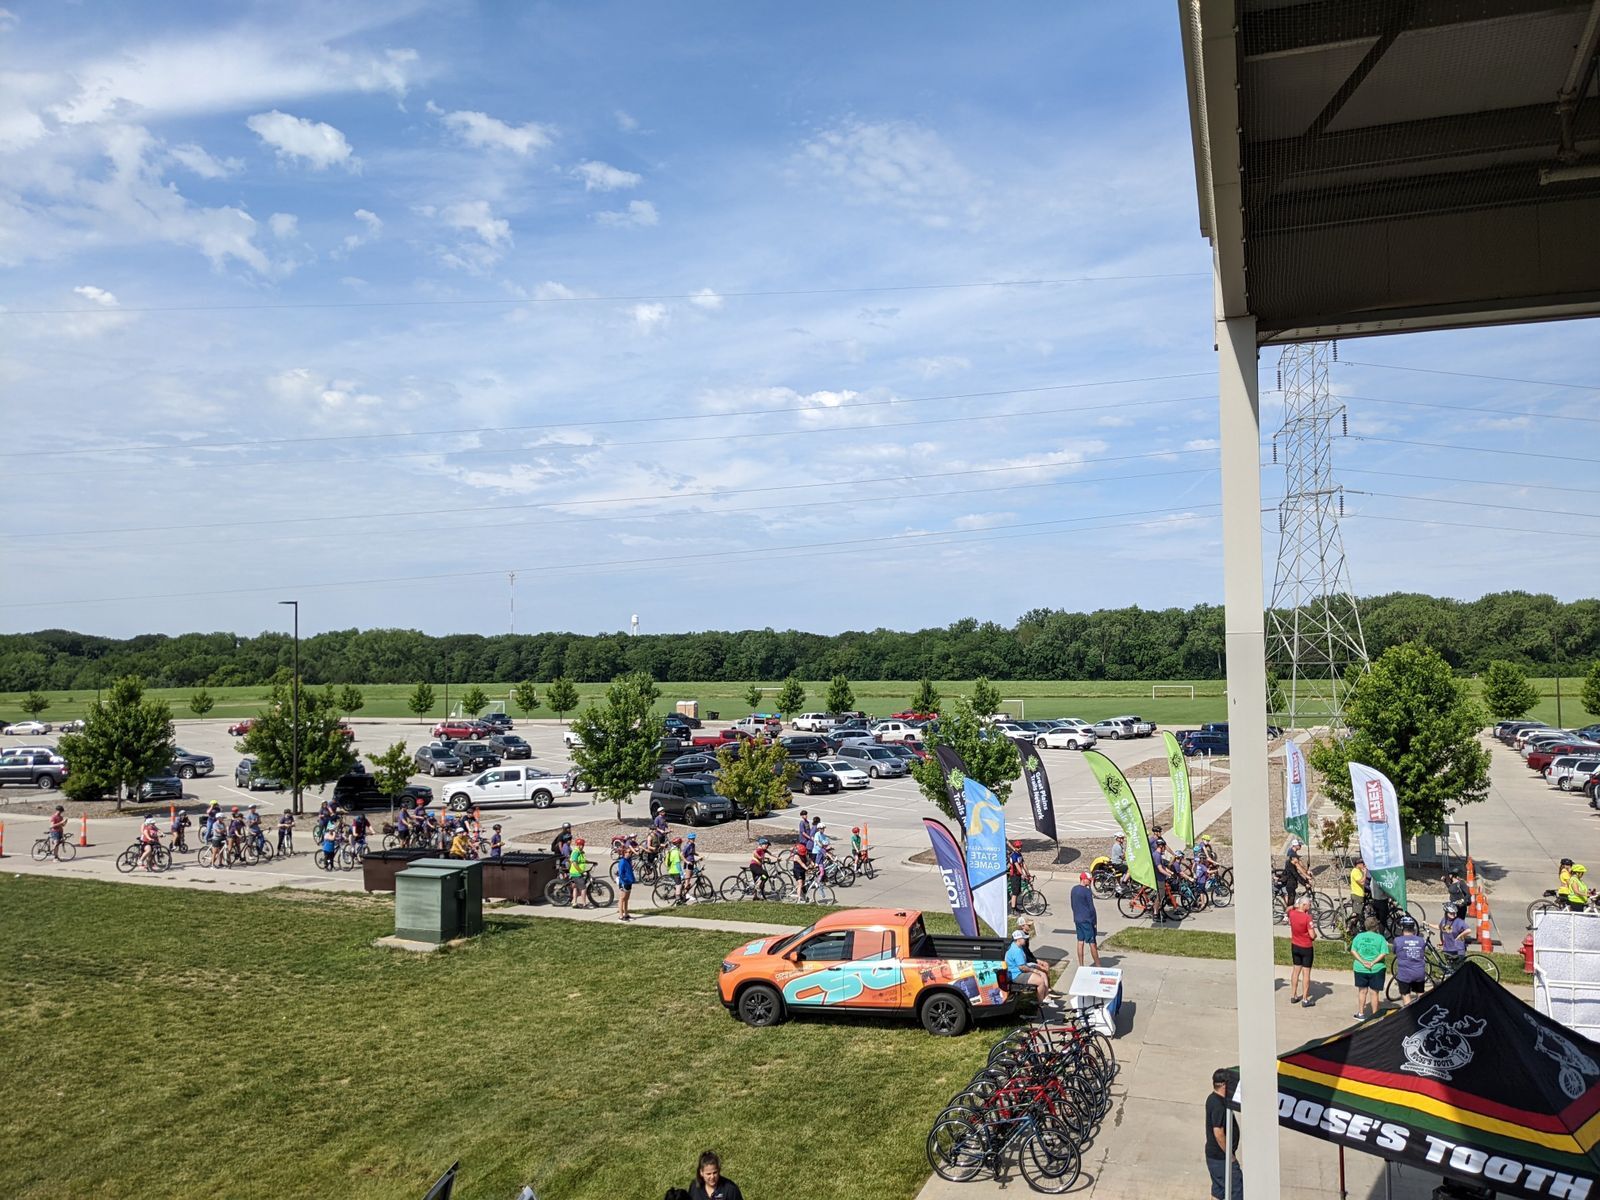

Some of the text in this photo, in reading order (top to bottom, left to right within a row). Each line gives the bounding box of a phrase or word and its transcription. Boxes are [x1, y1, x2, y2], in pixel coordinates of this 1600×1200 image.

[953, 791, 965, 815] Trails
[1033, 791, 1044, 820] Network
[1036, 772, 1048, 810] Great Plains
[940, 865, 960, 908] LOPT
[1433, 1059, 1455, 1067] TOOTH
[1425, 1135, 1594, 1200] TOOTH
